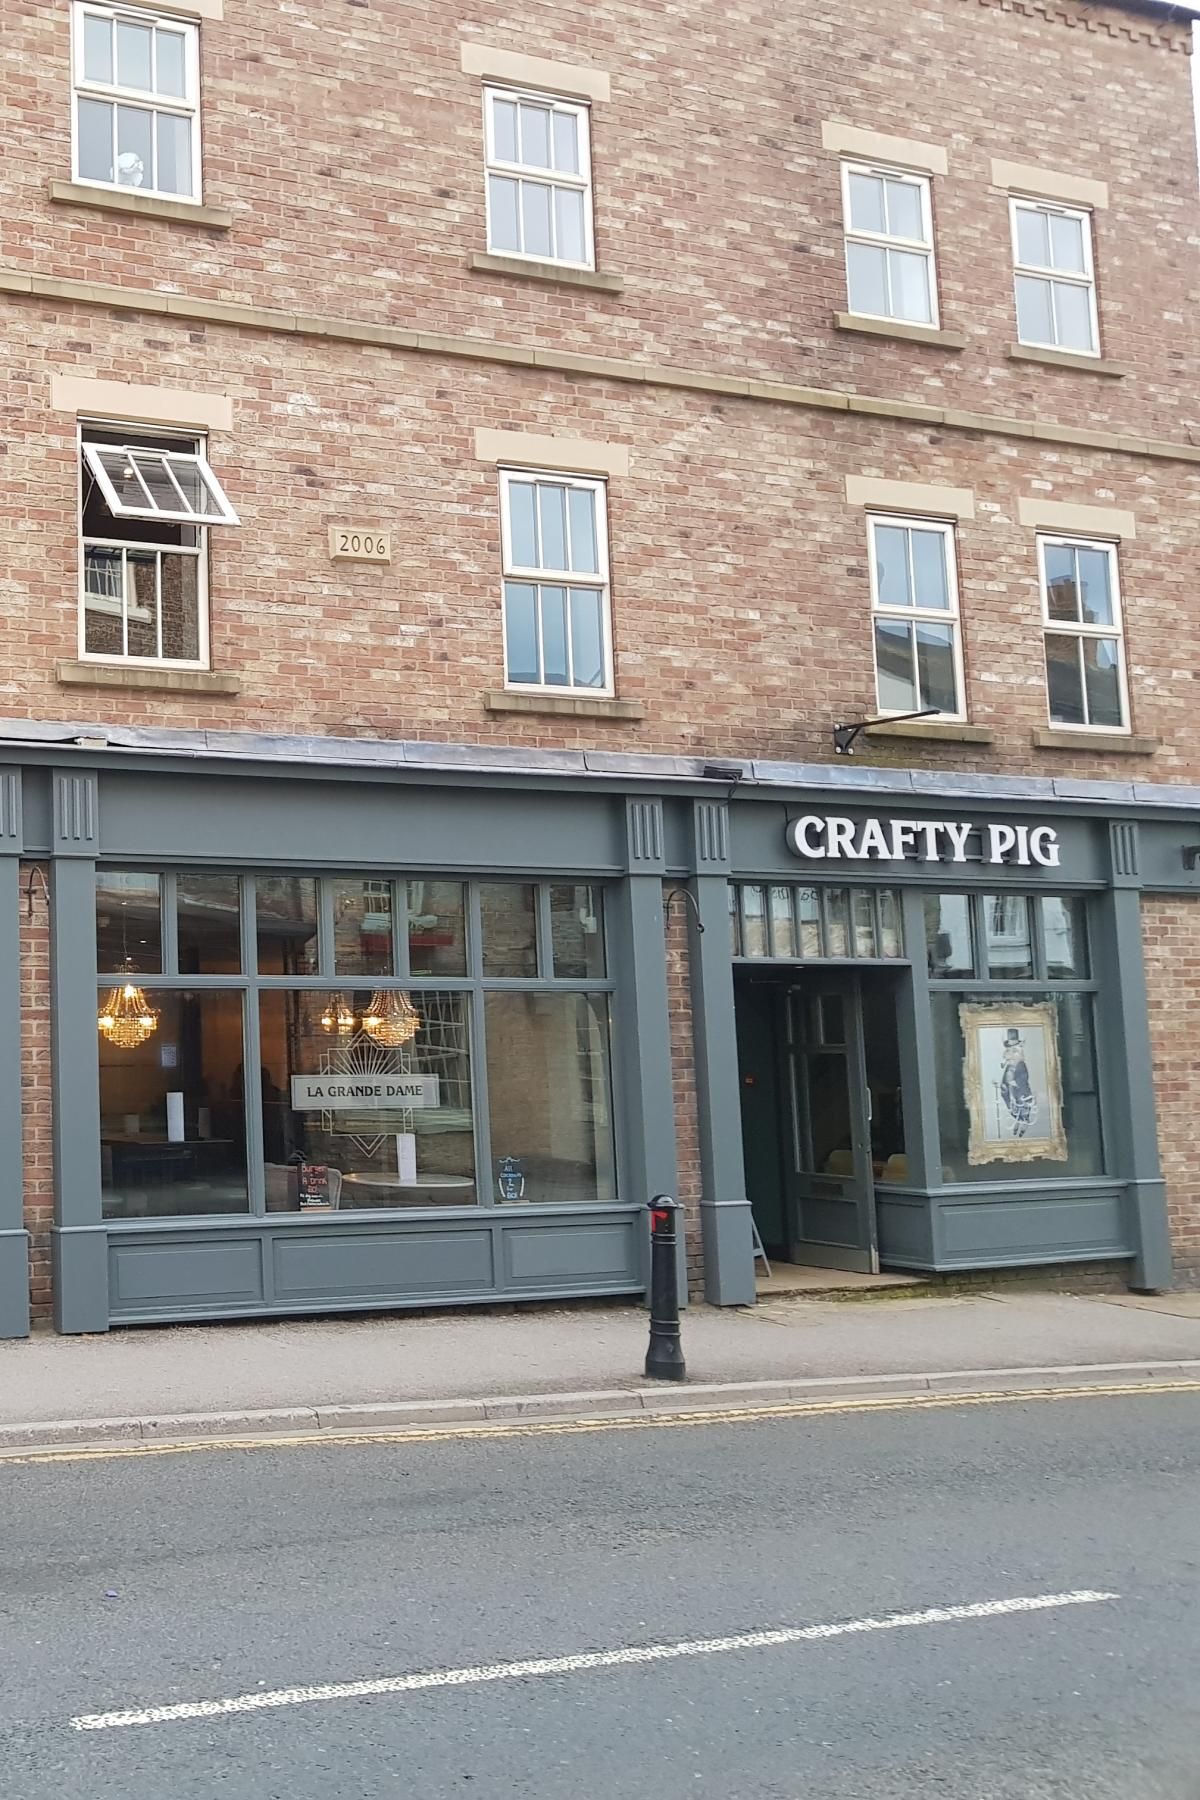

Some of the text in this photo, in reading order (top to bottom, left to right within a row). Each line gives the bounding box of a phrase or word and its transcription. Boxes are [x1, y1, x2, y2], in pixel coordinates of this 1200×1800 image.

[339, 534, 386, 555] 2006
[793, 814, 1061, 867] CRAFTY PIG
[306, 1085, 424, 1098] LA GRANDE DAME
